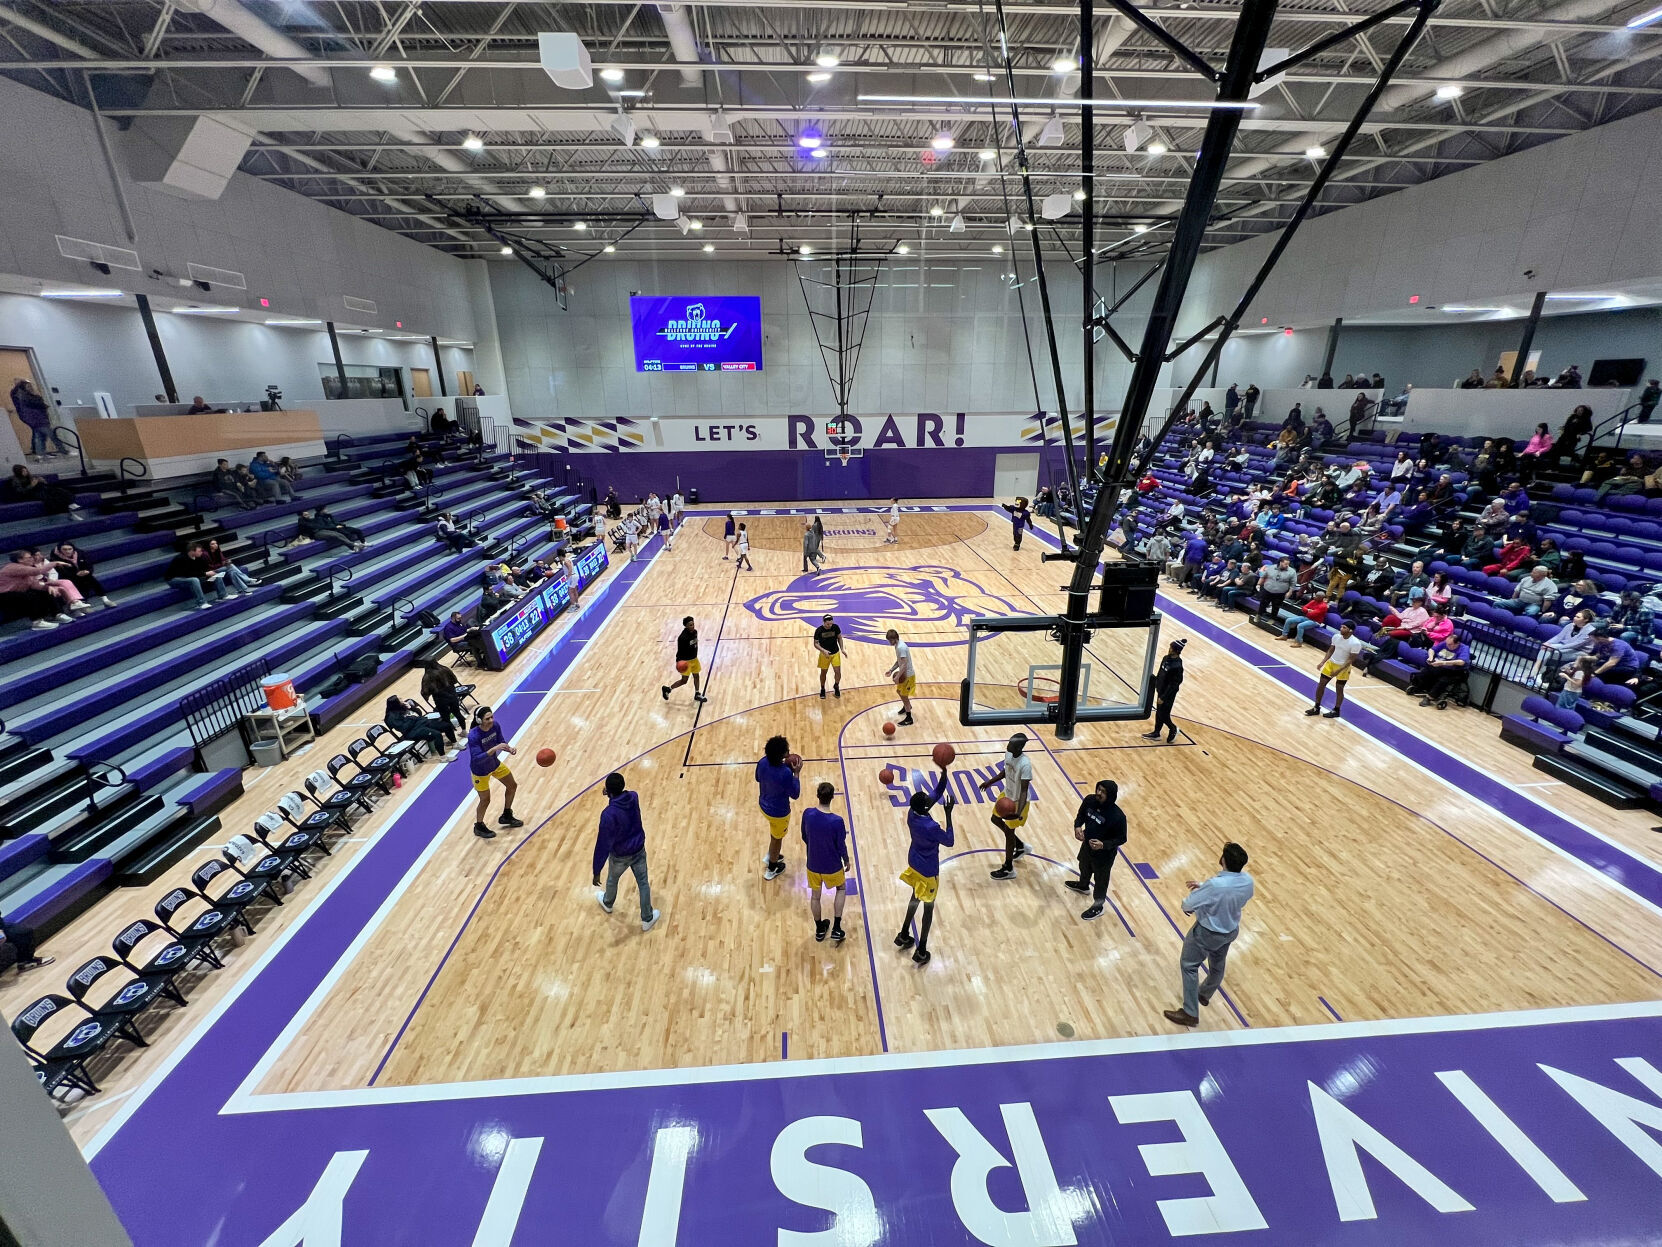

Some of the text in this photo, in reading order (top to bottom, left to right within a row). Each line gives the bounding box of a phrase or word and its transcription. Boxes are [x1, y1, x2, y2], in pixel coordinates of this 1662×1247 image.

[704, 363, 716, 371] VS
[694, 413, 966, 449] LET'S ROAR!
[731, 506, 949, 515] BELLEVUE
[823, 528, 877, 538] BRUINS
[503, 609, 539, 648] 38 04:13 22
[885, 760, 1039, 807] RUINS
[120, 922, 149, 946] BRUINS
[75, 959, 107, 985] BRUINS
[22, 998, 57, 1027] BRUINS
